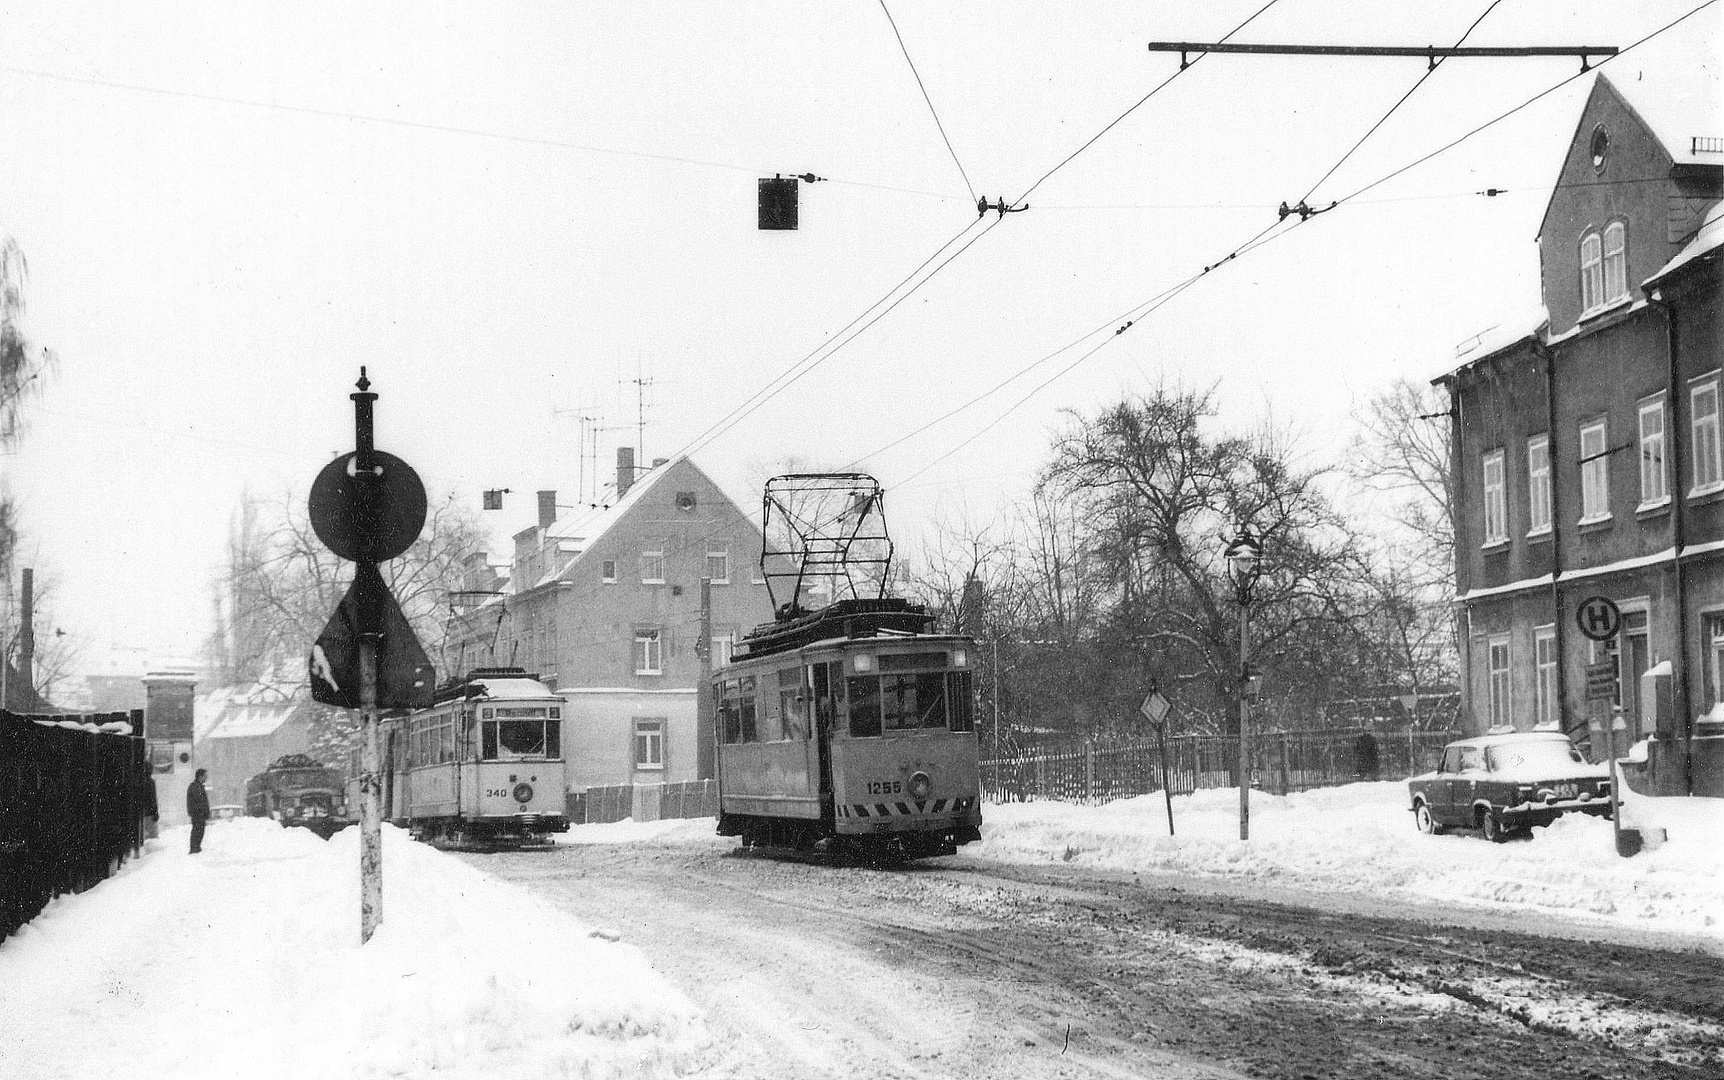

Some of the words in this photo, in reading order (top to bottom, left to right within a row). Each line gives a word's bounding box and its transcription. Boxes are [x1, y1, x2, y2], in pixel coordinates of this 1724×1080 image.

[1587, 605, 1610, 632] H
[486, 789, 507, 798] 340
[867, 781, 901, 795] 1255
